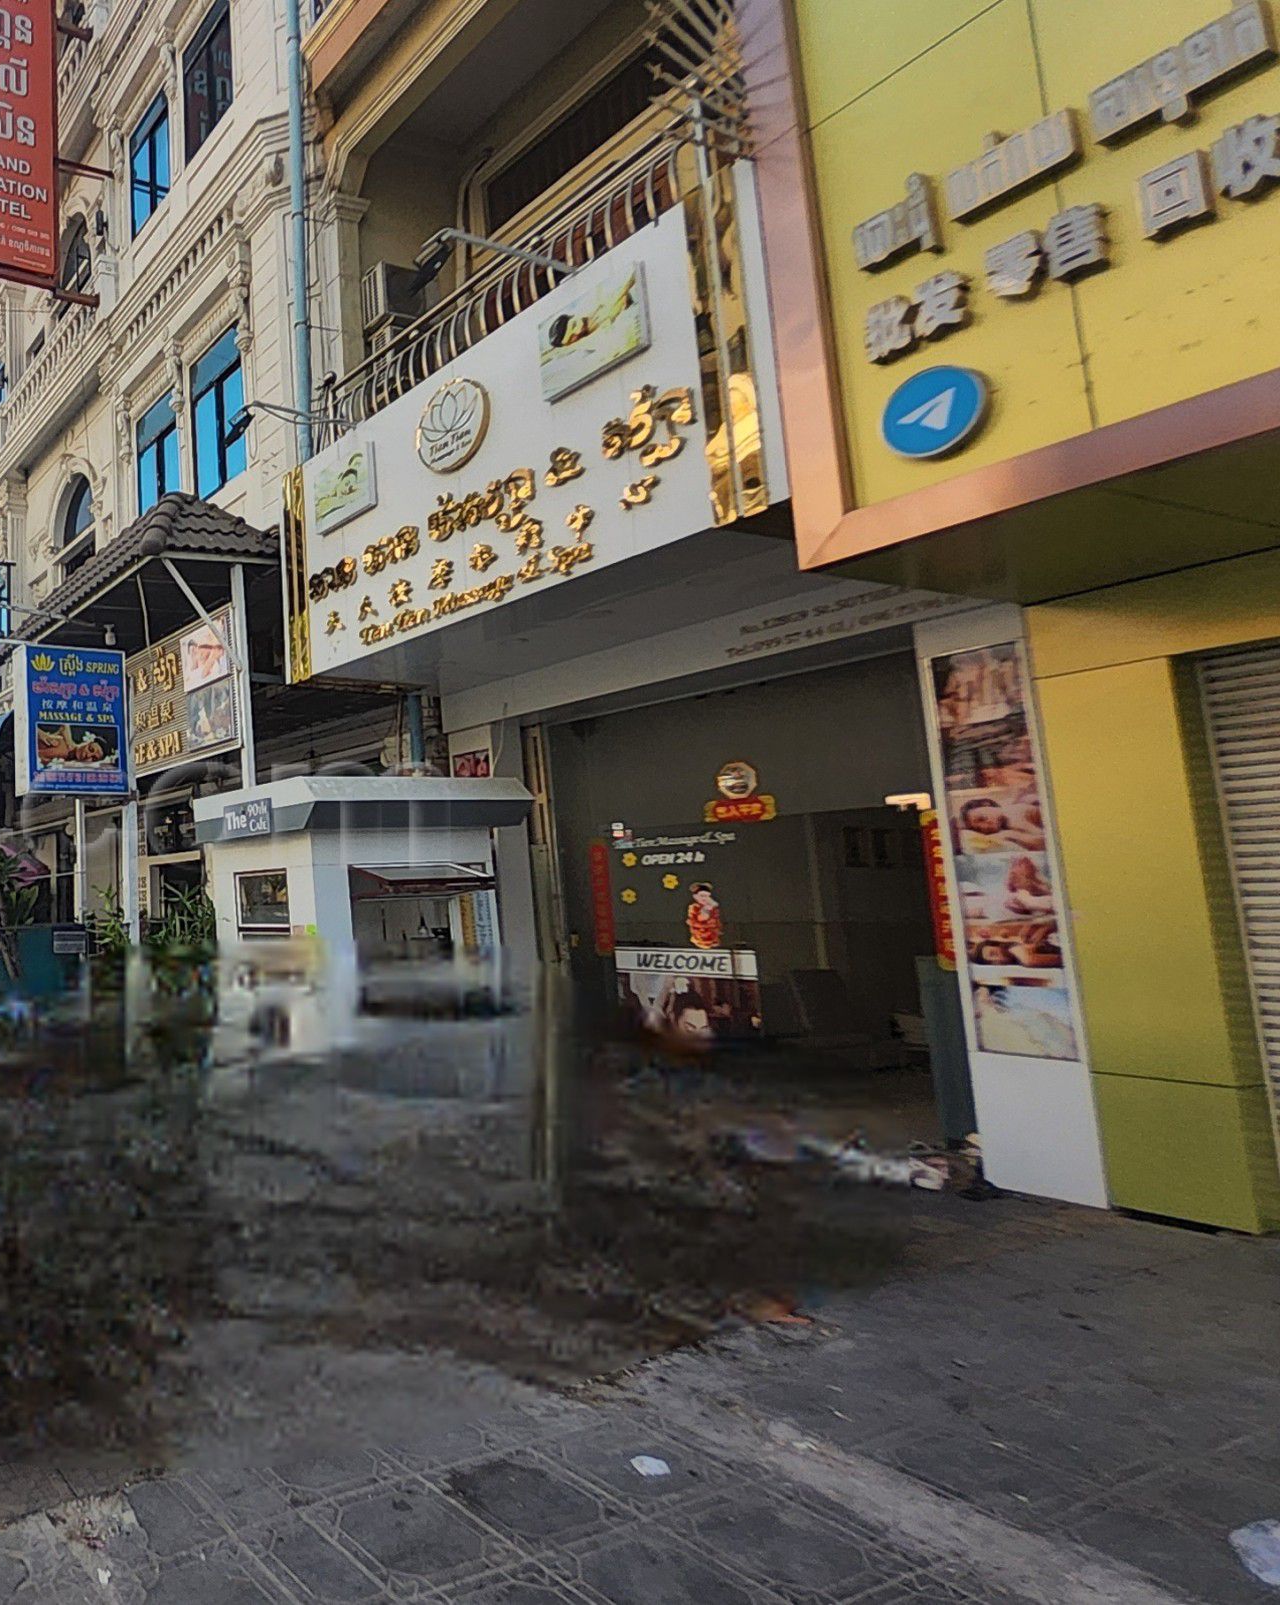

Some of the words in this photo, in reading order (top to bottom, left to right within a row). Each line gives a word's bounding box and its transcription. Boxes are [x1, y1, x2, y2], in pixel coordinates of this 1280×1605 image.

[864, 269, 971, 363] 批发
[984, 202, 1108, 299] 零售
[1137, 113, 1280, 240] 回收
[86, 662, 119, 675] SPRING
[137, 668, 148, 692] &
[79, 683, 90, 697] &
[39, 711, 83, 722] MASSAGE
[86, 712, 94, 722] &
[97, 713, 115, 724] SPA
[147, 739, 158, 760] &
[158, 731, 181, 758] SPA
[225, 811, 247, 830] The
[641, 853, 674, 866] OPEN
[676, 852, 693, 864] 24
[636, 952, 729, 972] WELCOME
